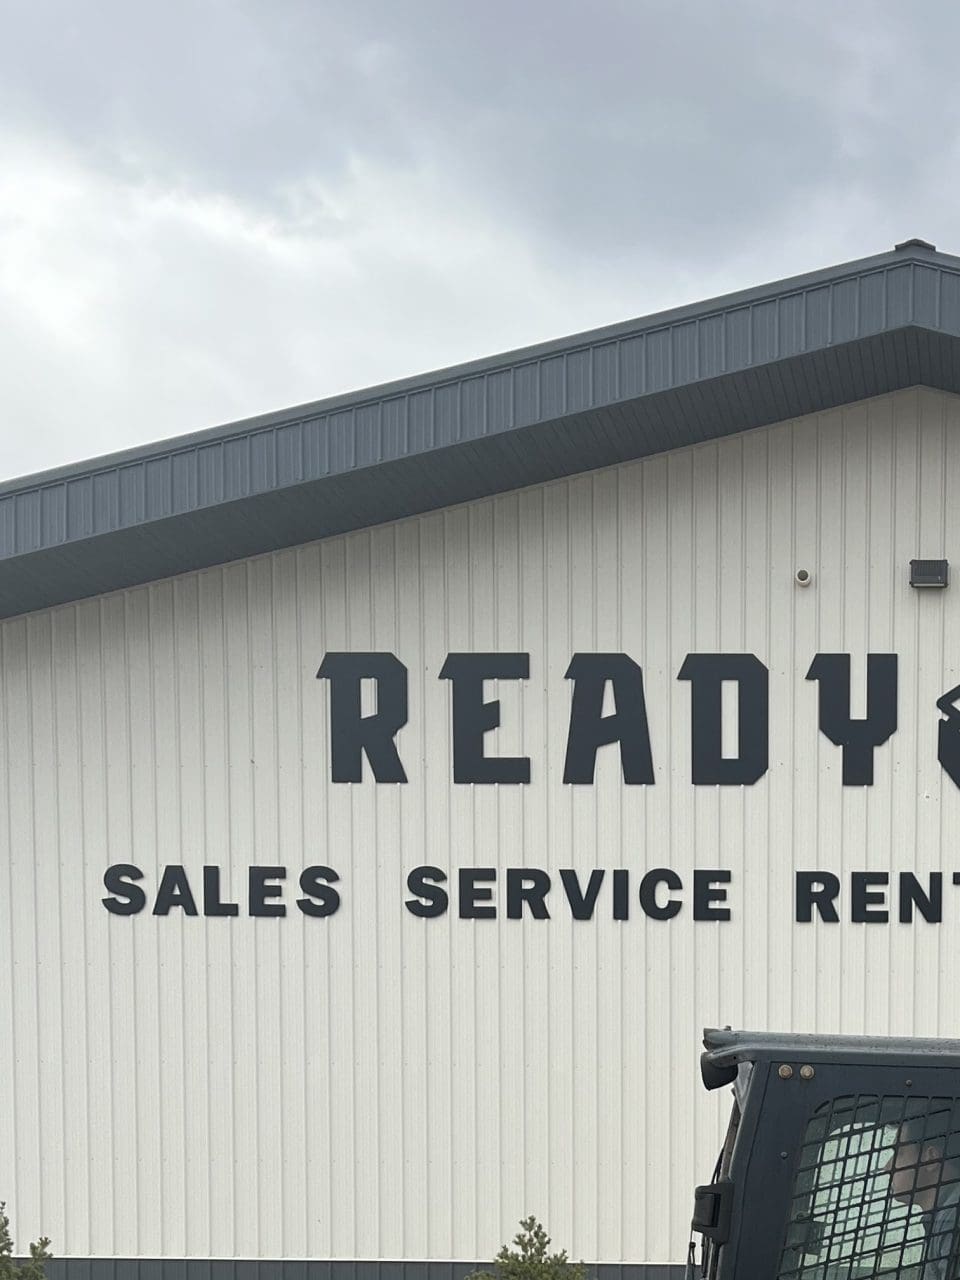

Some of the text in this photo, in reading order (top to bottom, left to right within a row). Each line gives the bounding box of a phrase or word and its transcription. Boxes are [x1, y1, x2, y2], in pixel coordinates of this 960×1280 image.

[316, 652, 897, 786] READY
[102, 864, 340, 918] SALES
[405, 866, 731, 921] SERVICE
